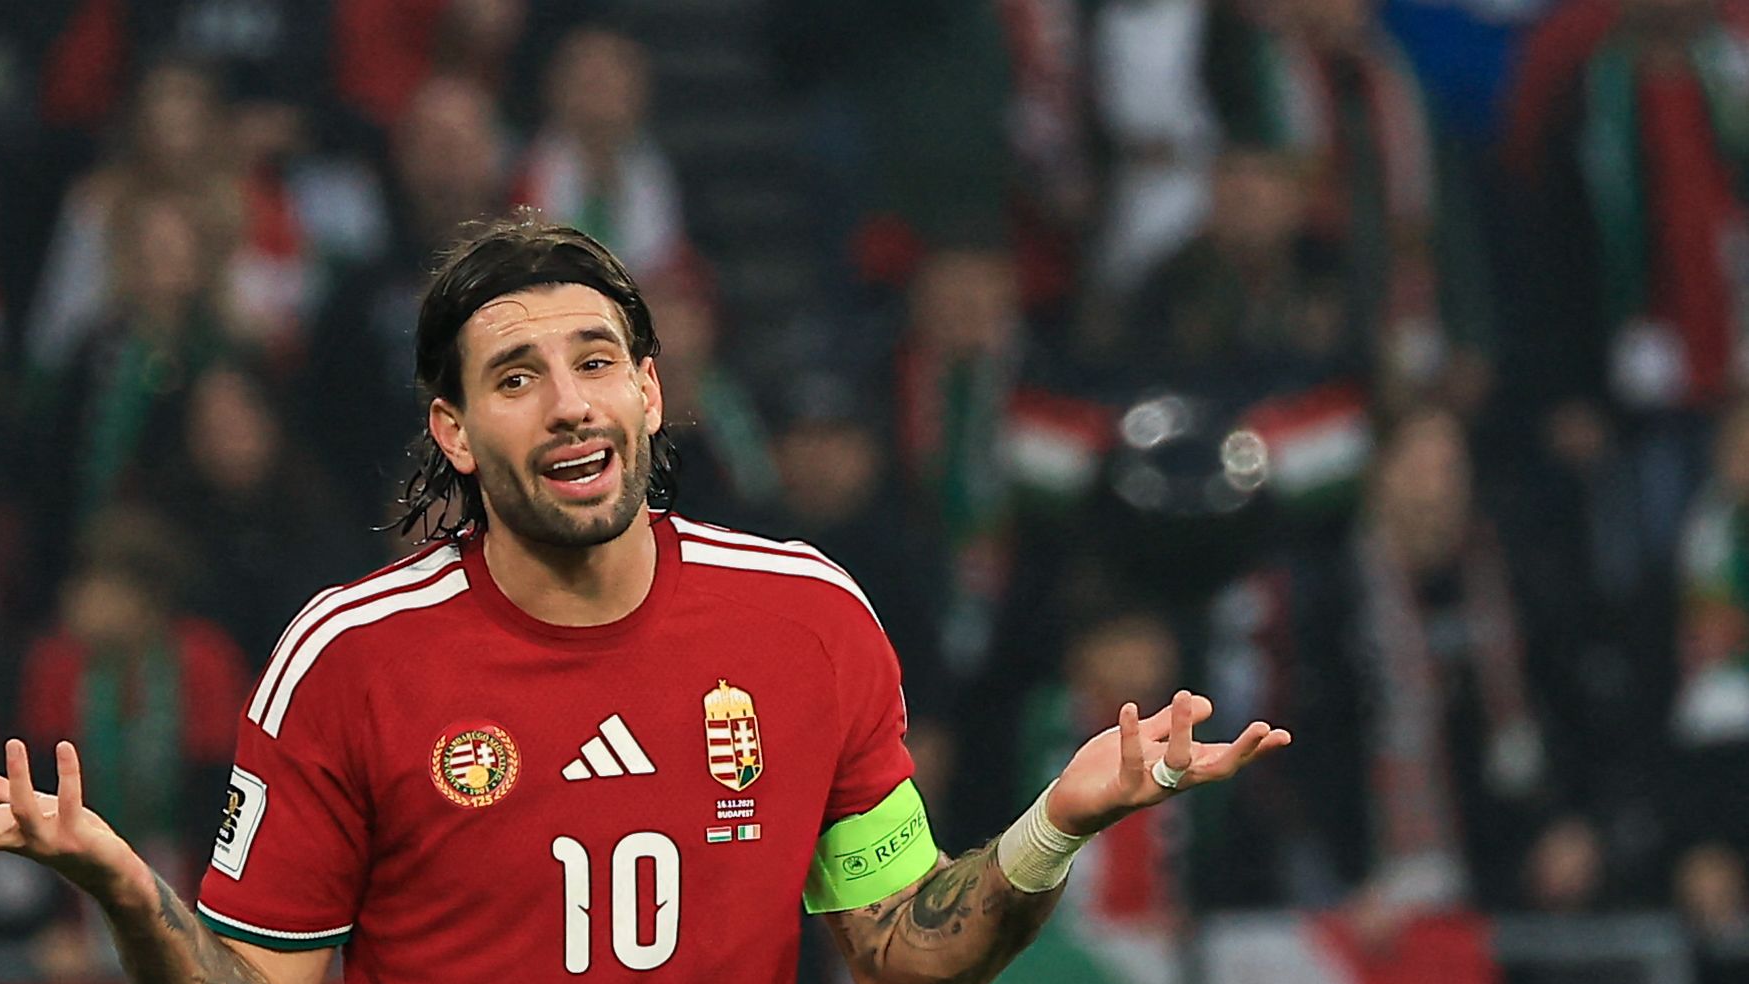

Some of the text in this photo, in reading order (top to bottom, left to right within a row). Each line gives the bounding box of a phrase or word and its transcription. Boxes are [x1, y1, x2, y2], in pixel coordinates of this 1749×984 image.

[470, 795, 494, 808] 125
[717, 809, 754, 819] BUDAPEST
[874, 810, 926, 863] RESPE
[552, 831, 680, 974] 10
